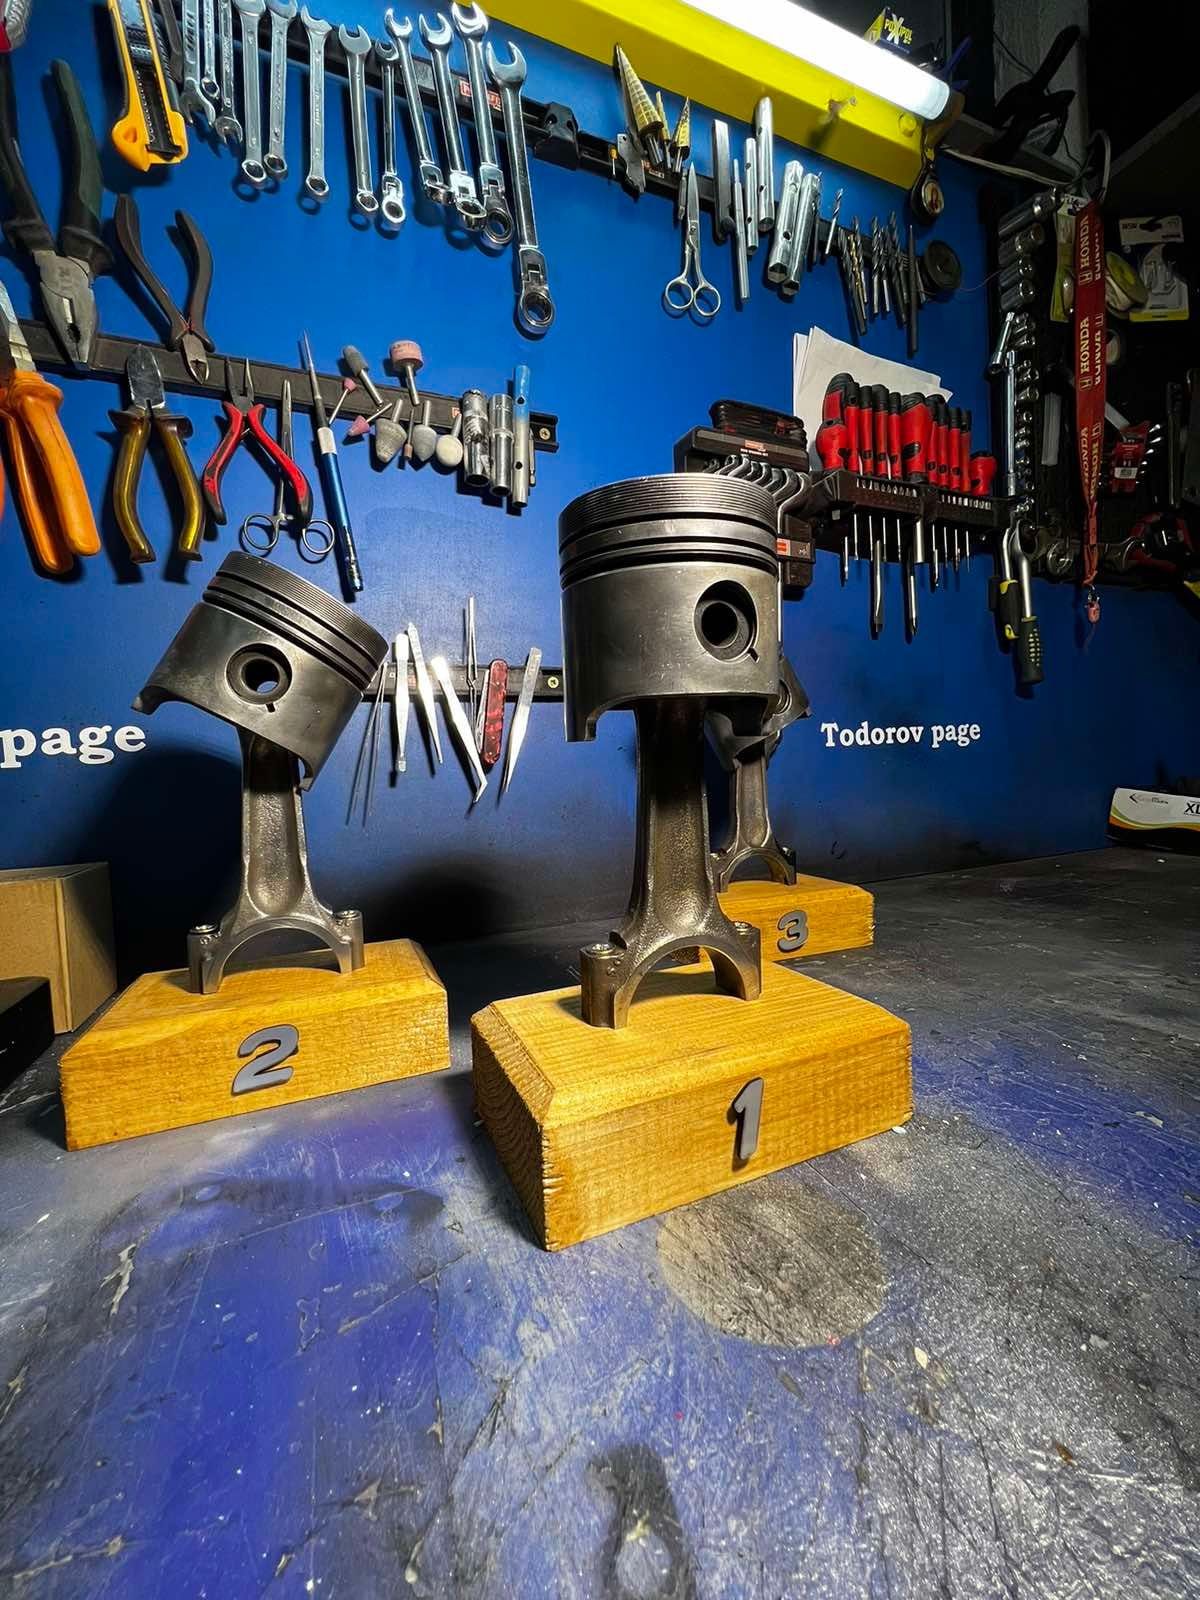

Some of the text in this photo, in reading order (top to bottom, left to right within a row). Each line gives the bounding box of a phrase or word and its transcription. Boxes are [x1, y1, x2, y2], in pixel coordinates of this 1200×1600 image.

[1080, 215, 1090, 269] HONDA
[1080, 316, 1090, 375] HONDA
[0, 725, 146, 769] page
[820, 721, 981, 748] Todorov page
[777, 910, 808, 953] 3
[231, 1024, 299, 1096] 2
[732, 1077, 764, 1161] 1
